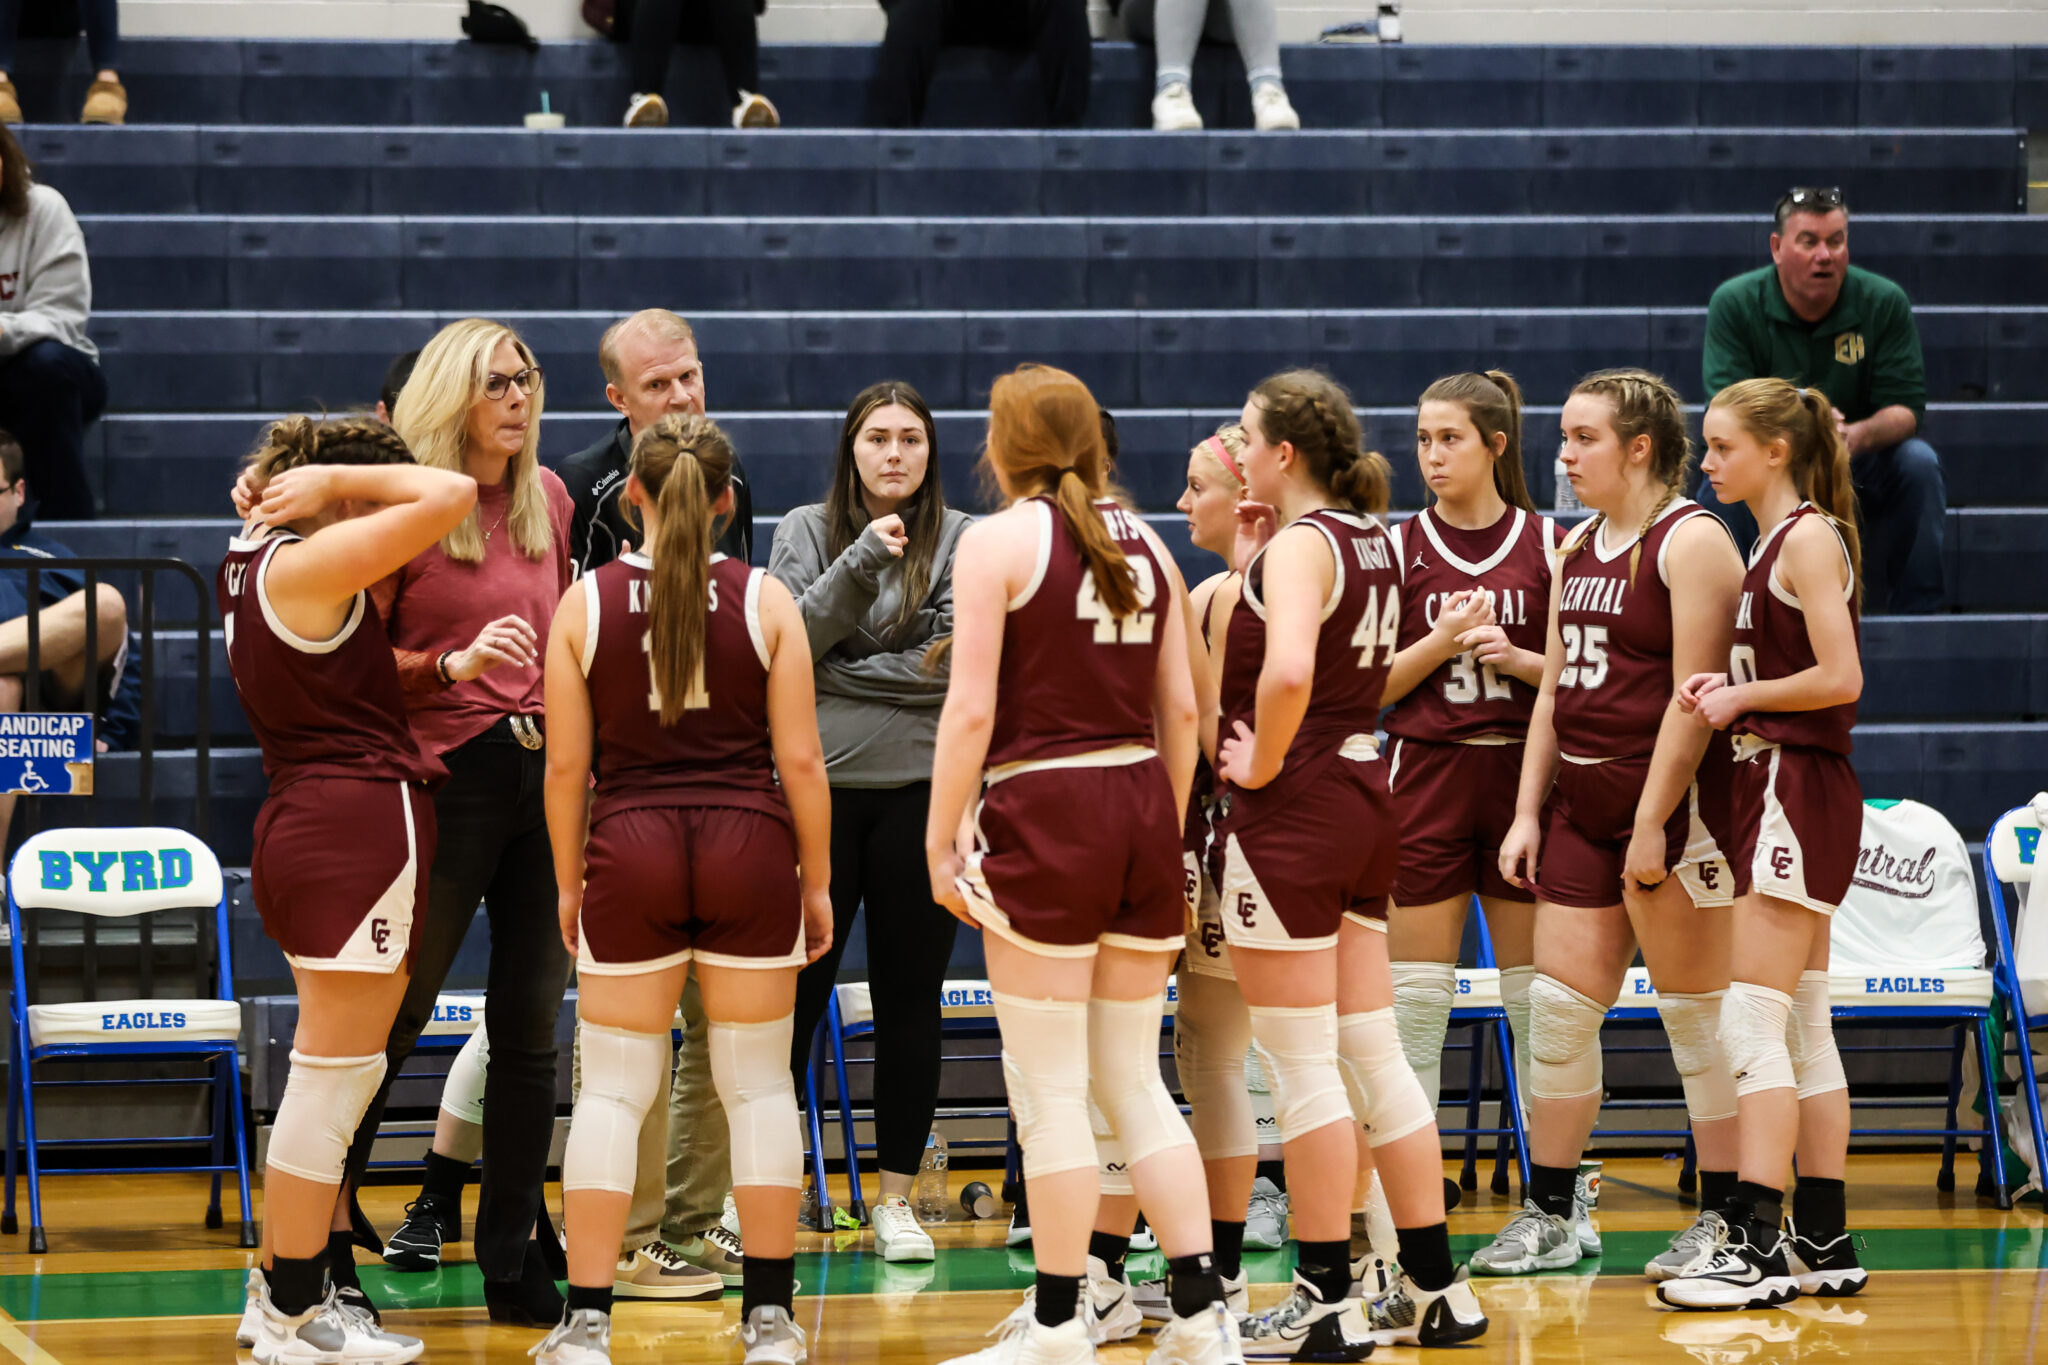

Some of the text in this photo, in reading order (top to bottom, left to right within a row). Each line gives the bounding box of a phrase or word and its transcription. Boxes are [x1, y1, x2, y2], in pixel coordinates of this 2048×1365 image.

[1076, 554, 1157, 644] 42
[1559, 576, 1627, 615] CENTRAL
[1350, 584, 1400, 668] 44
[1558, 623, 1609, 690] 25
[0, 716, 85, 736] ANDICAP
[0, 738, 76, 758] SEATING
[38, 848, 193, 892] BYRD
[1865, 977, 1945, 994] EAGLES
[102, 1012, 186, 1030] EAGLES
[432, 1005, 473, 1022] LES
